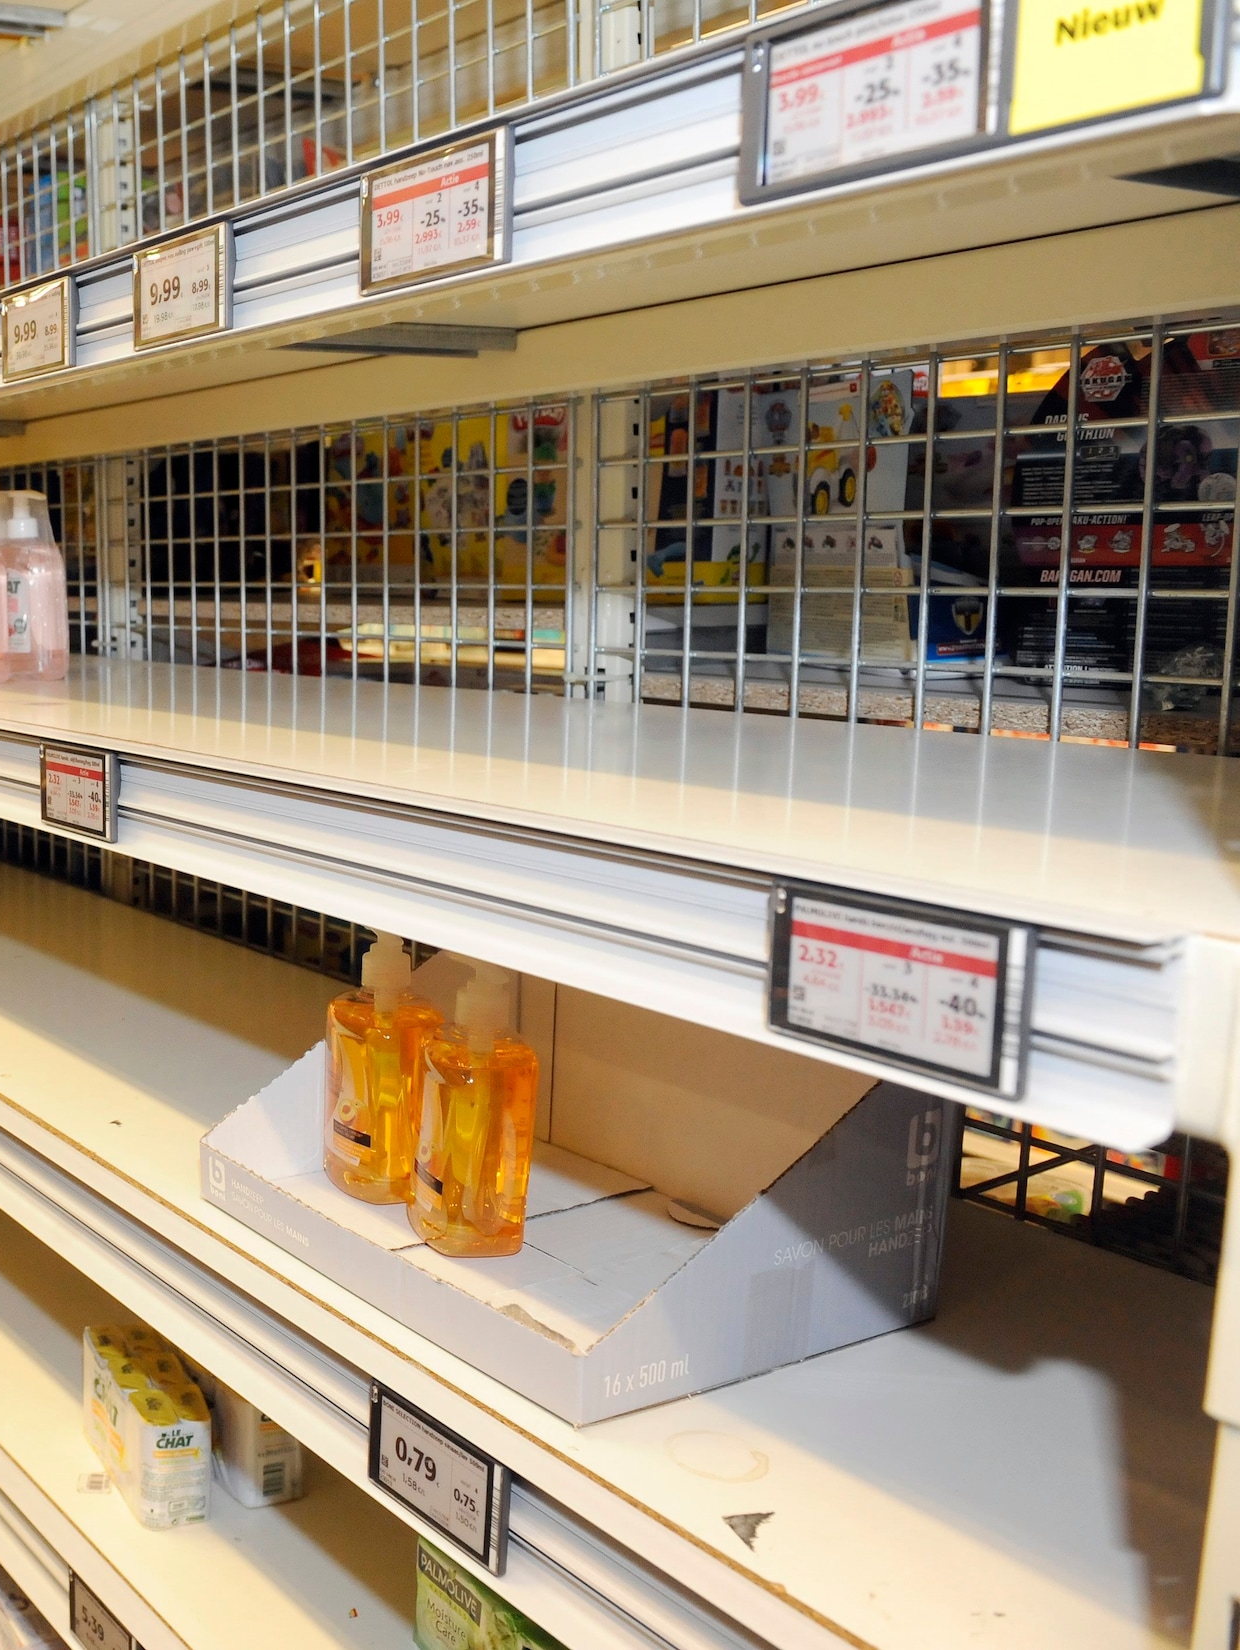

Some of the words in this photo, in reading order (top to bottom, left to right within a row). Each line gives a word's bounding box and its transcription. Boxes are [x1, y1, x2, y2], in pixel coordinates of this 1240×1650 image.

[1055, 0, 1165, 46] Nieuw
[440, 173, 460, 188] Actie
[474, 180, 479, 191] 4
[437, 192, 442, 203] 2
[285, 1225, 310, 1248] MAINS
[774, 1237, 825, 1266] SAVON
[828, 1226, 866, 1251] POUR
[870, 1218, 891, 1238] LES
[604, 1373, 621, 1398] 16
[626, 1374, 635, 1392] x
[639, 1360, 667, 1388] 500
[670, 1353, 690, 1379] ml
[156, 1435, 194, 1449] CHAT
[172, 1429, 181, 1437] LE
[421, 1553, 477, 1618] PALMOLIVE
[427, 1598, 466, 1641] Moisture
[435, 1620, 457, 1646] Care
